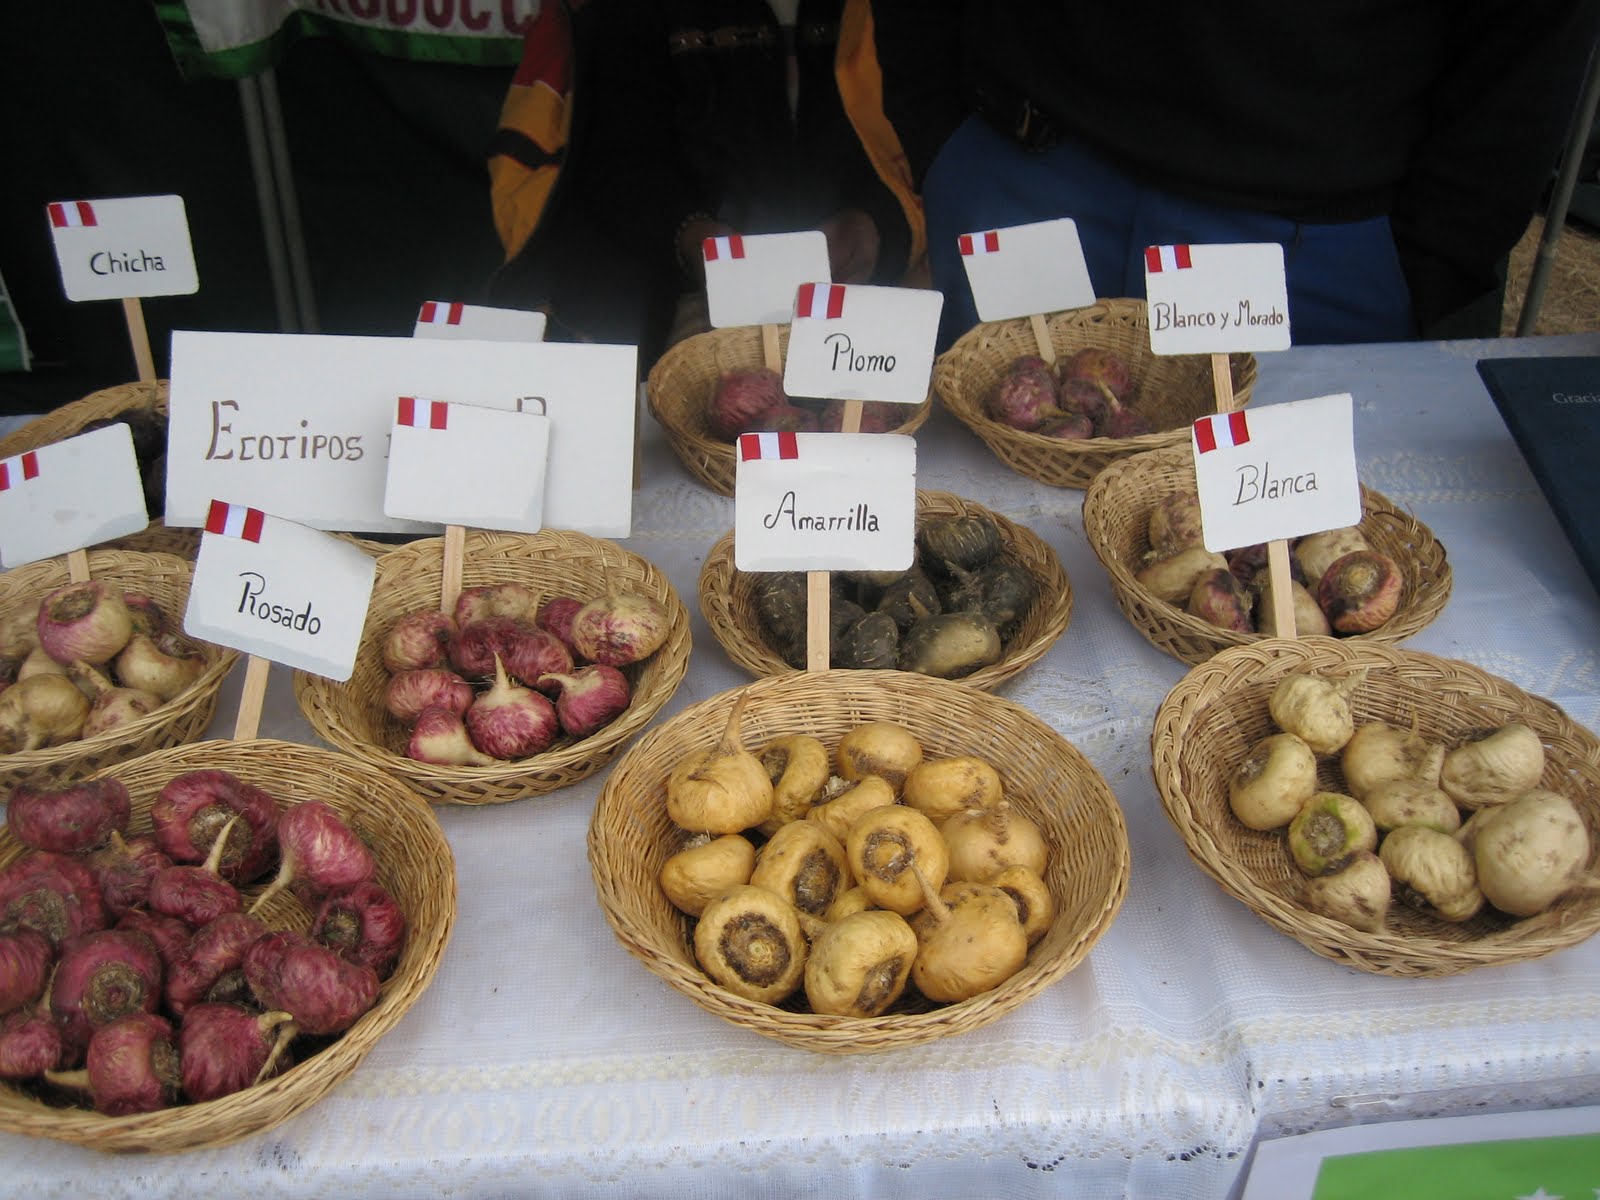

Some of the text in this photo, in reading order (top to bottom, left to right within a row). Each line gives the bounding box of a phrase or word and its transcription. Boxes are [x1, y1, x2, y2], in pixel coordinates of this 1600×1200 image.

[90, 250, 165, 276] Chicha
[1153, 300, 1284, 331] Blanco y Morado
[824, 332, 896, 373] Plomo
[1232, 461, 1318, 506] Blanca
[763, 491, 880, 532] Amarrilla
[238, 571, 321, 635] Rosado
